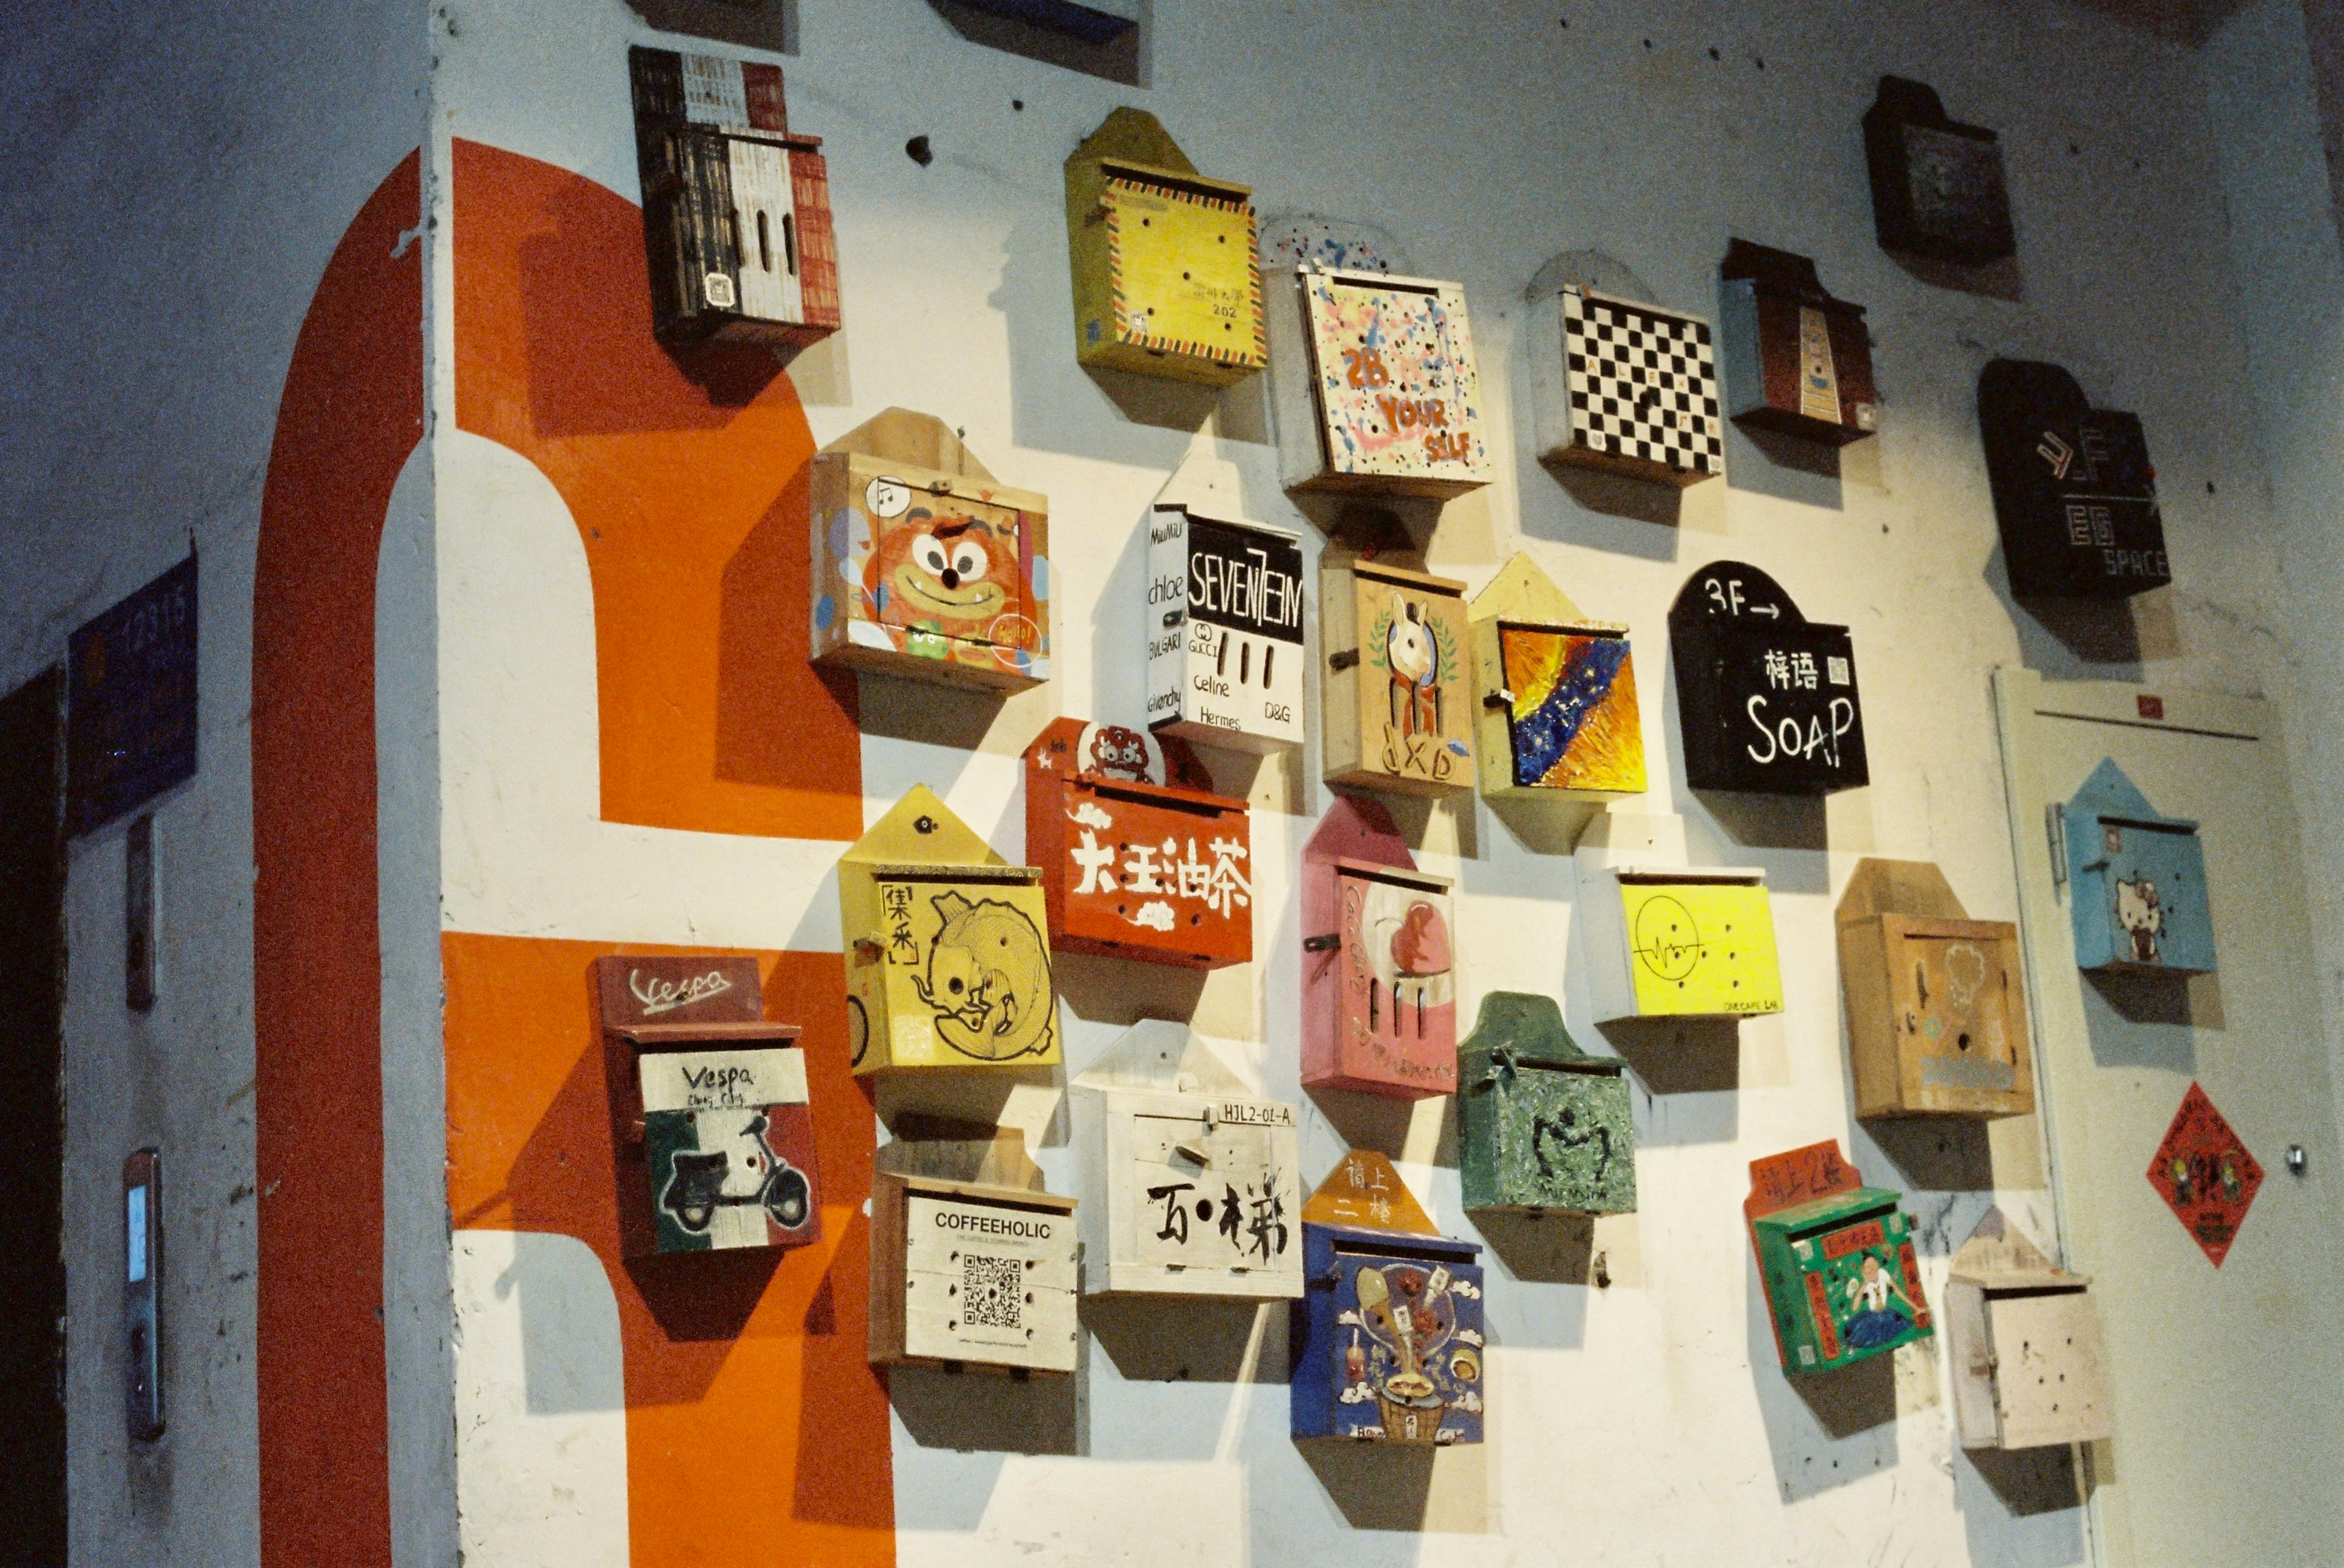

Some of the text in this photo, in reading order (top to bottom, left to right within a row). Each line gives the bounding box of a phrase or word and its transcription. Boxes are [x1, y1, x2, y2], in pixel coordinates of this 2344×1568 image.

[1213, 303, 1237, 318] 202
[1342, 346, 1390, 391] 2B
[1375, 392, 1450, 437] YOUR
[1424, 432, 1470, 464] SELF
[2103, 549, 2169, 577] SPACE
[1148, 574, 1184, 605] chloe
[1705, 578, 1745, 616] 3F
[1149, 632, 1181, 660] BVLGARI
[1188, 640, 1218, 657] GUCCI
[1764, 649, 1819, 690] 梓语
[1148, 685, 1181, 713] Givenchy
[1194, 675, 1229, 697] Celine
[1200, 706, 1241, 731] Hermes
[1265, 702, 1291, 723] D&G
[1747, 694, 1855, 768] SOAP
[1070, 828, 1253, 920] 大王油茶
[630, 968, 731, 1013] Vespa
[681, 1066, 754, 1104] Vespa
[935, 1212, 1051, 1239] COFFEEHOLIC
